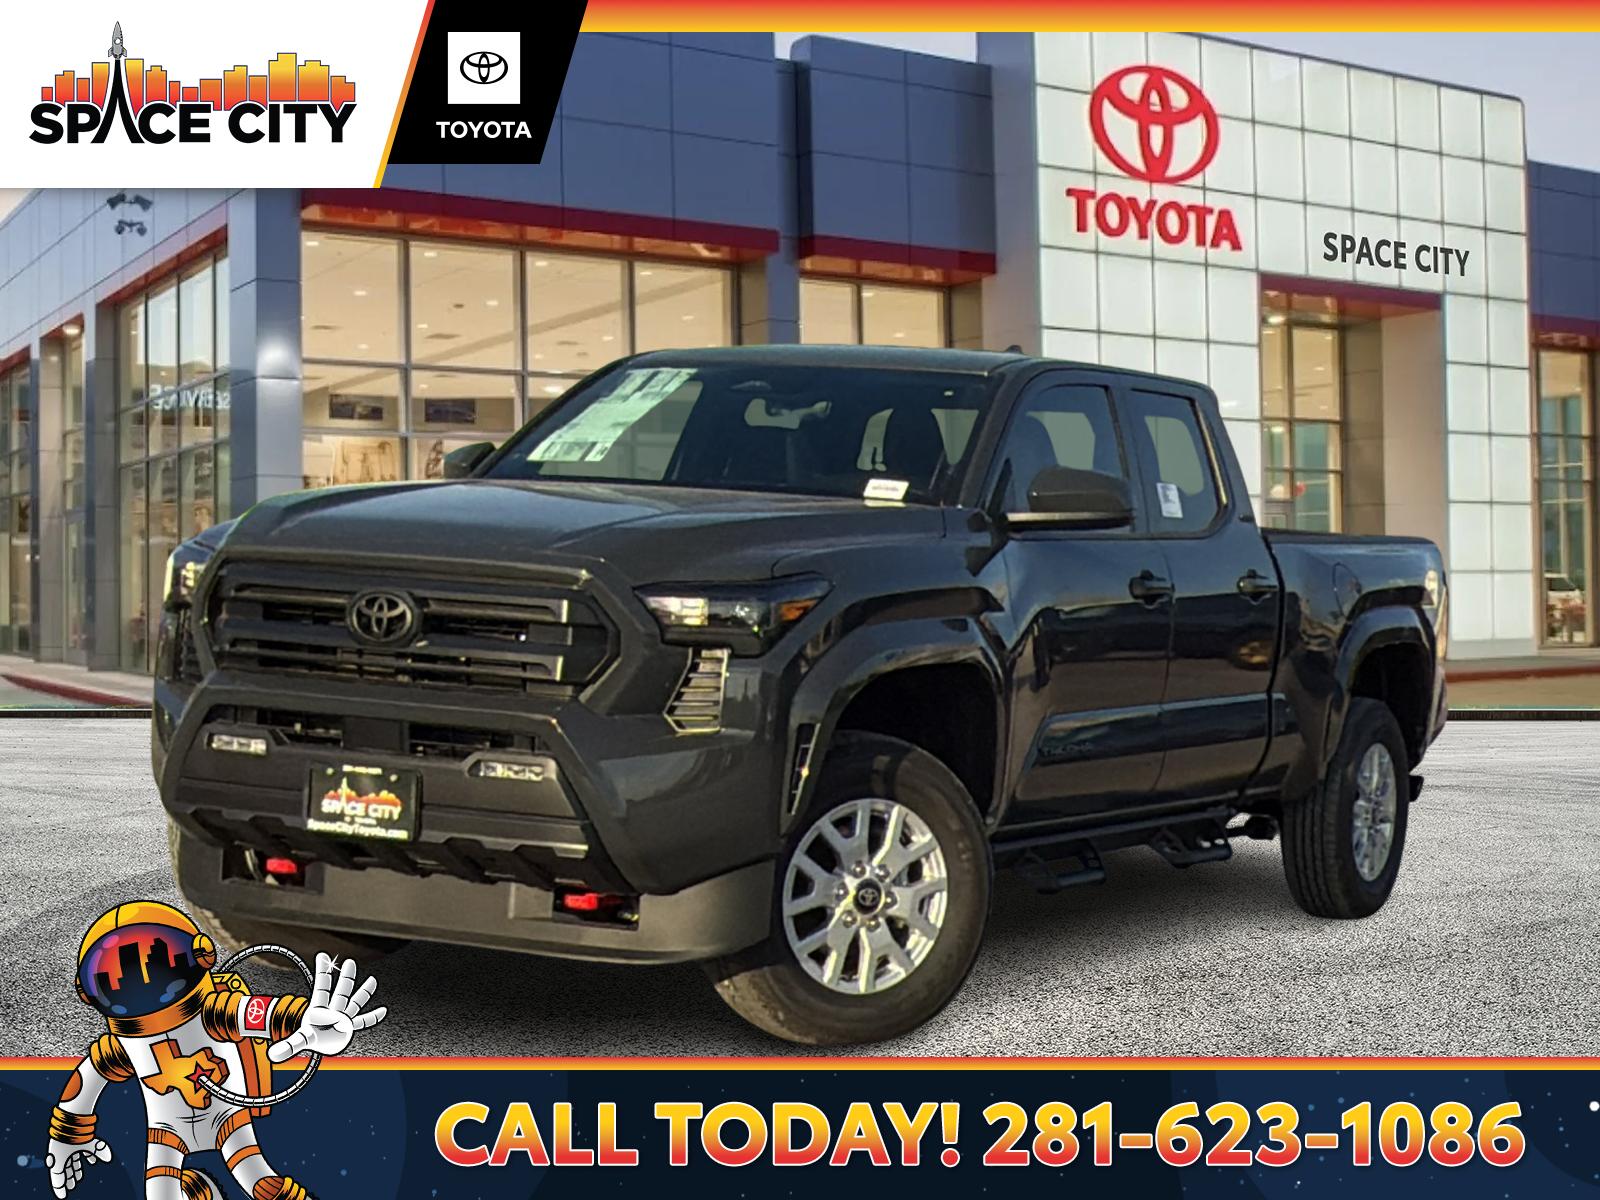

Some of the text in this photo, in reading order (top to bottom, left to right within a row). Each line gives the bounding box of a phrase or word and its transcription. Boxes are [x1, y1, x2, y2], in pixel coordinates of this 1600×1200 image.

[1065, 188, 1242, 251] TOYOTA
[1323, 232, 1471, 277] SPACE CITY
[321, 798, 402, 820] SPACE CITY
